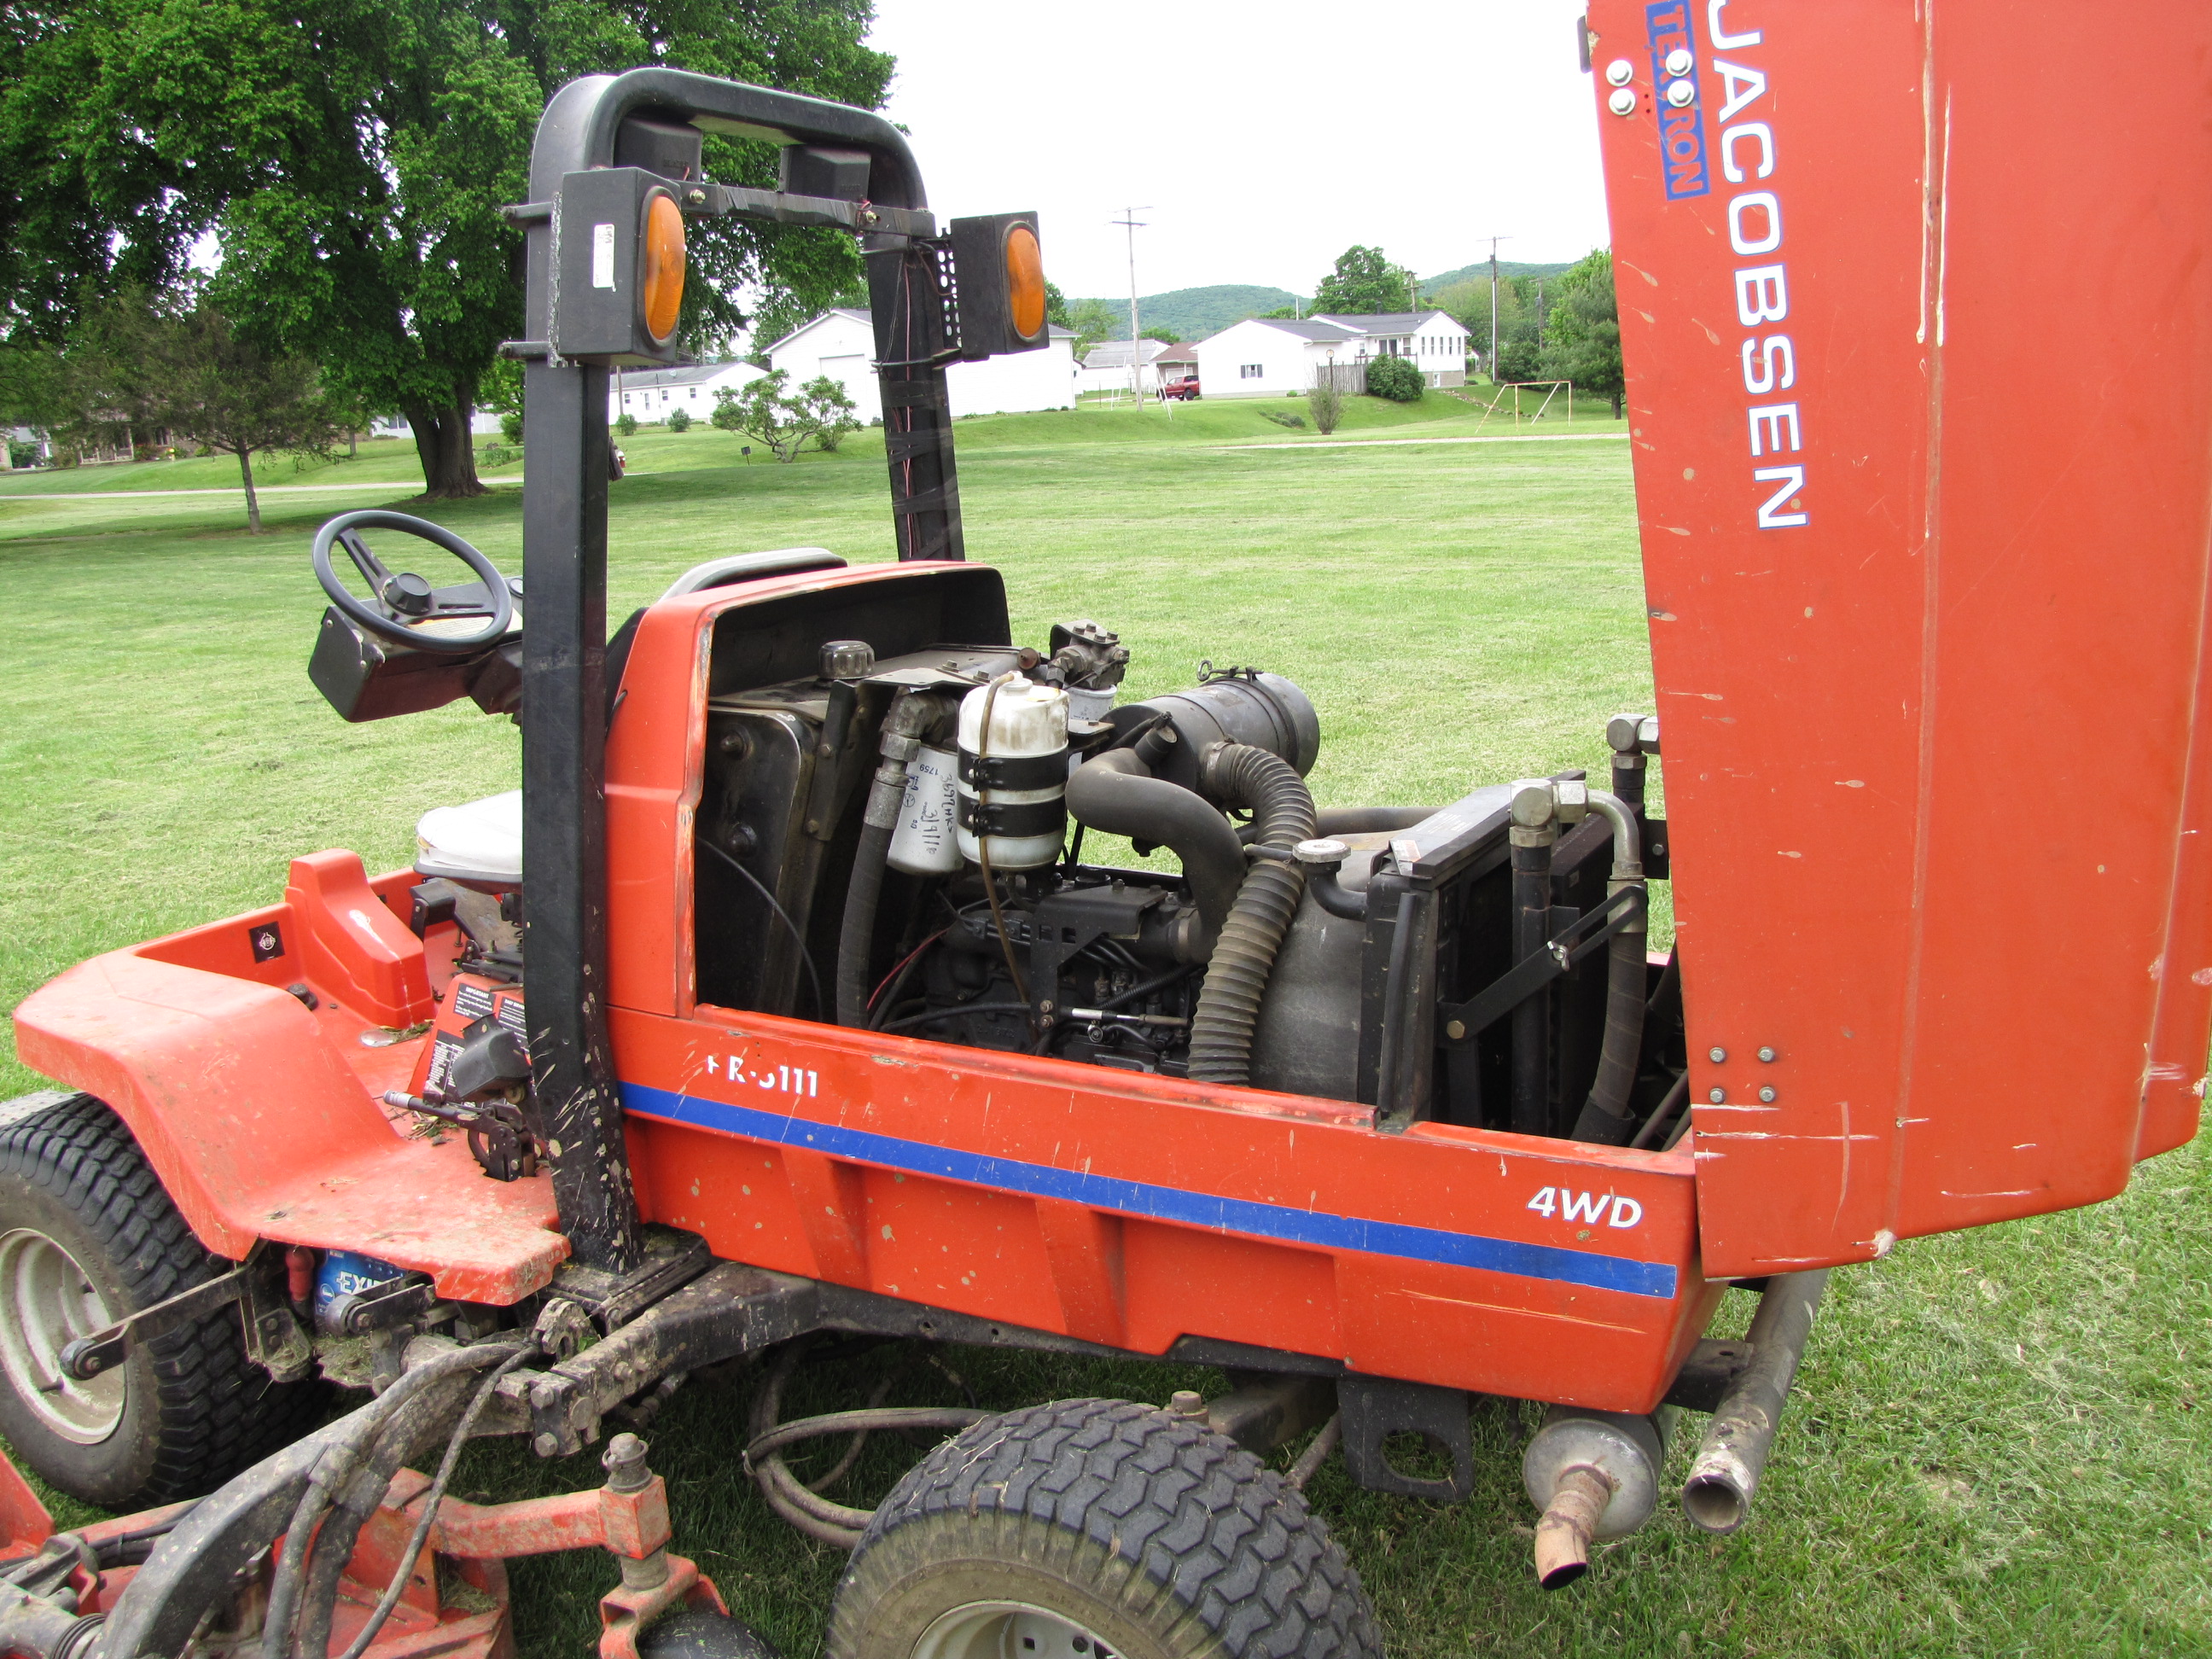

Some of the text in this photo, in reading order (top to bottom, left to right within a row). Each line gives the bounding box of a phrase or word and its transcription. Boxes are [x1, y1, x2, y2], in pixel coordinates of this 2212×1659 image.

[1654, 4, 1703, 195] TEXRON
[1708, 0, 1808, 530] JACOBSEN
[919, 764, 939, 776] 1759
[465, 987, 489, 998] IMPORTANT
[1526, 1185, 1644, 1229] 4WD
